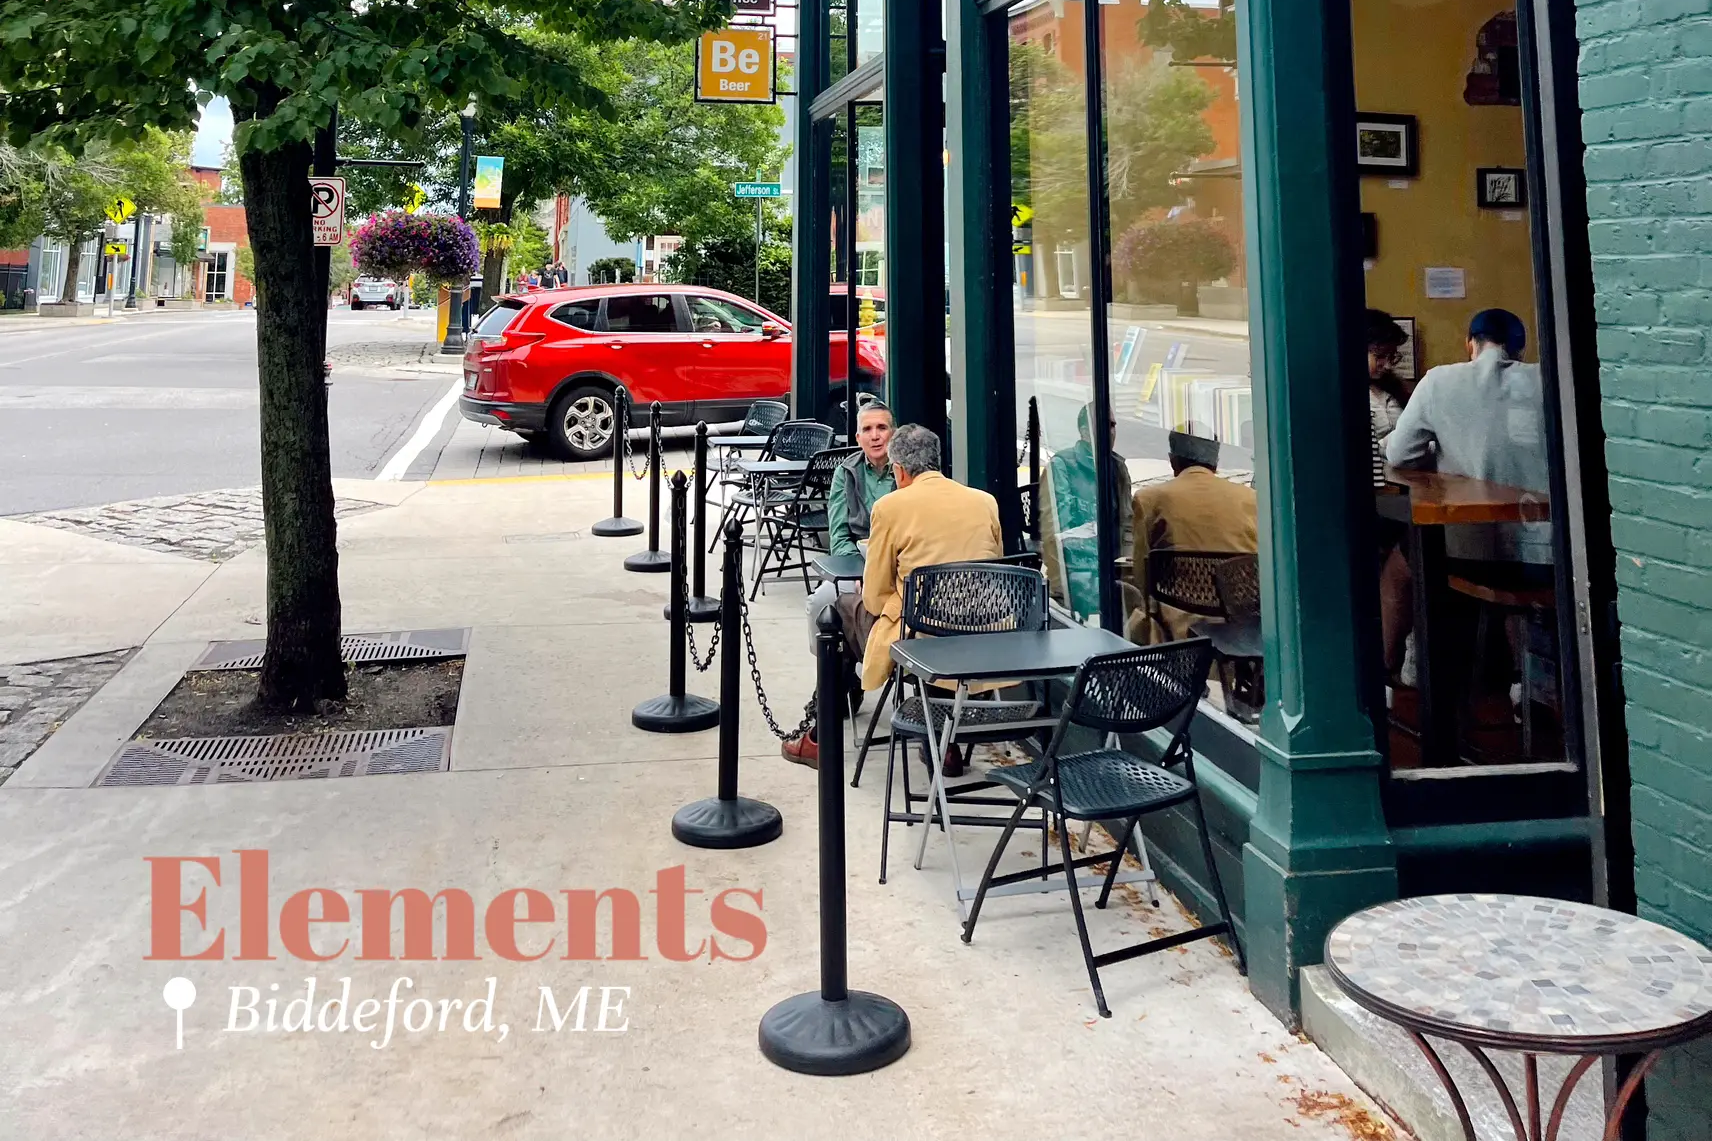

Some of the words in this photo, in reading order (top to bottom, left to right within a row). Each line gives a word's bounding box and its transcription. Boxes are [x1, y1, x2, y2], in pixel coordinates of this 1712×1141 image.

[757, 32, 768, 41] 21
[711, 40, 760, 74] Be
[719, 78, 751, 91] Beer
[736, 184, 771, 195] Jefferson
[322, 232, 327, 242] 6
[328, 233, 339, 242] AM
